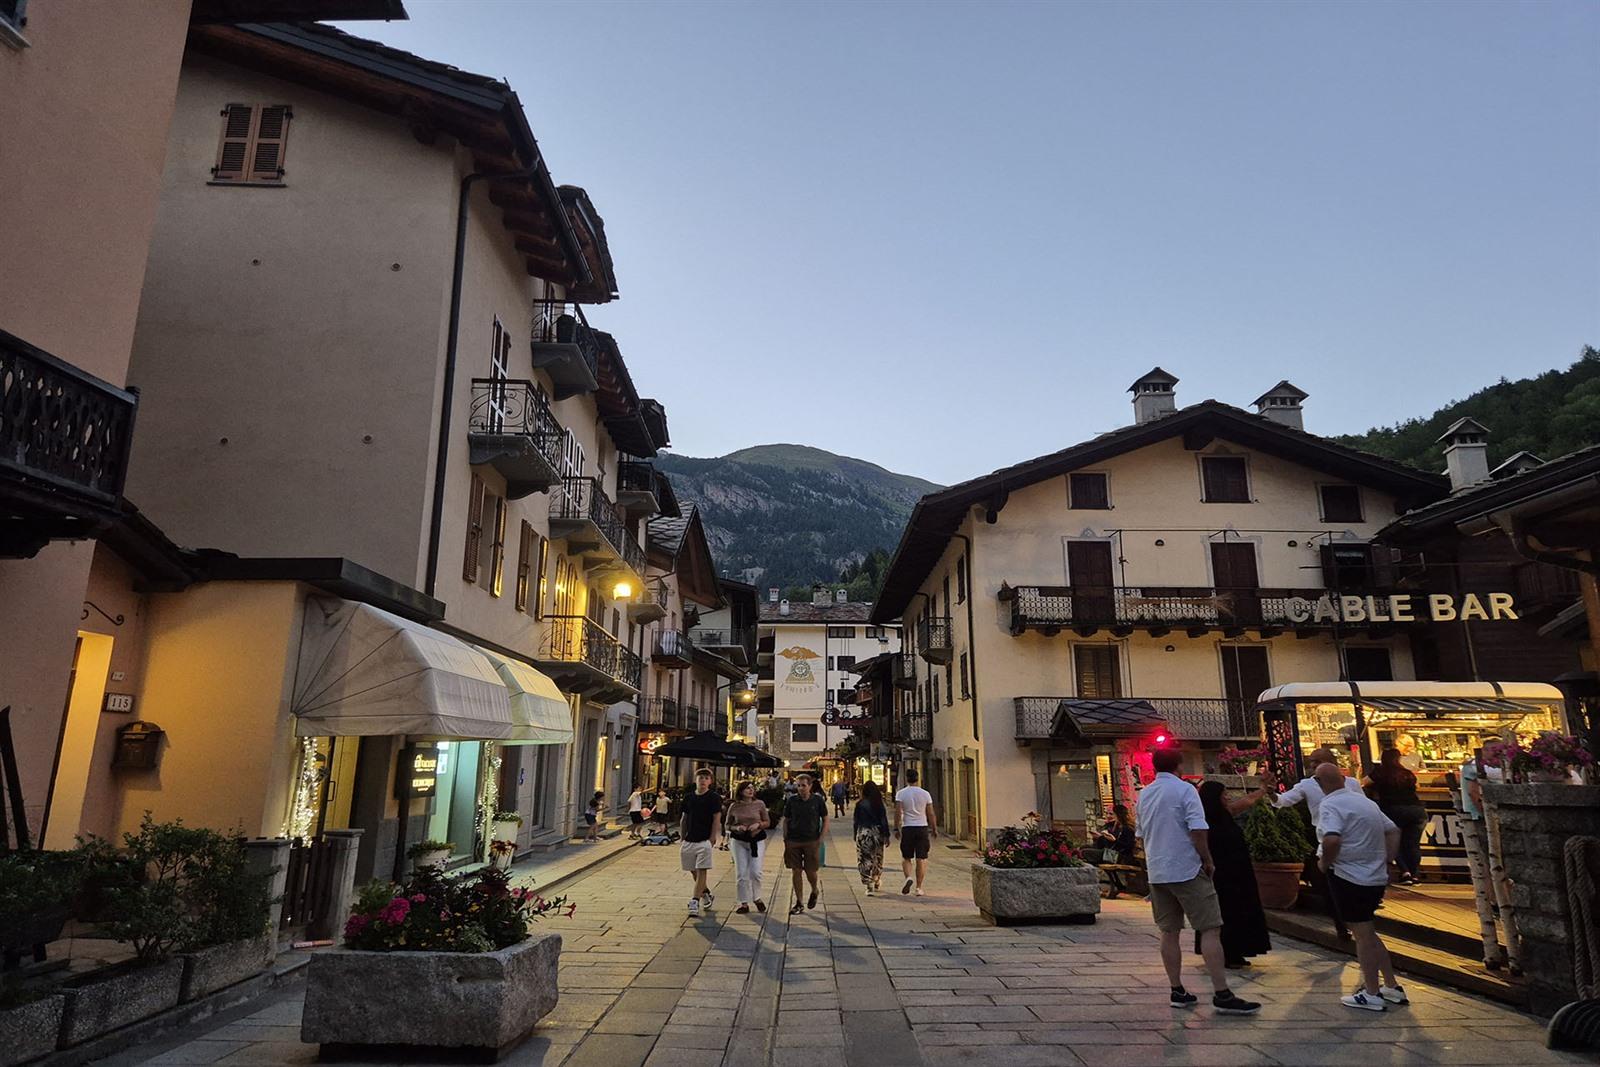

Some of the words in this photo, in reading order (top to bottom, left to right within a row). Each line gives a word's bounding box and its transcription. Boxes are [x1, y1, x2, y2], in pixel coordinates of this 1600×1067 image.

[1285, 594, 1415, 622] CABLE
[1428, 592, 1519, 621] BAR
[111, 697, 129, 708] 115
